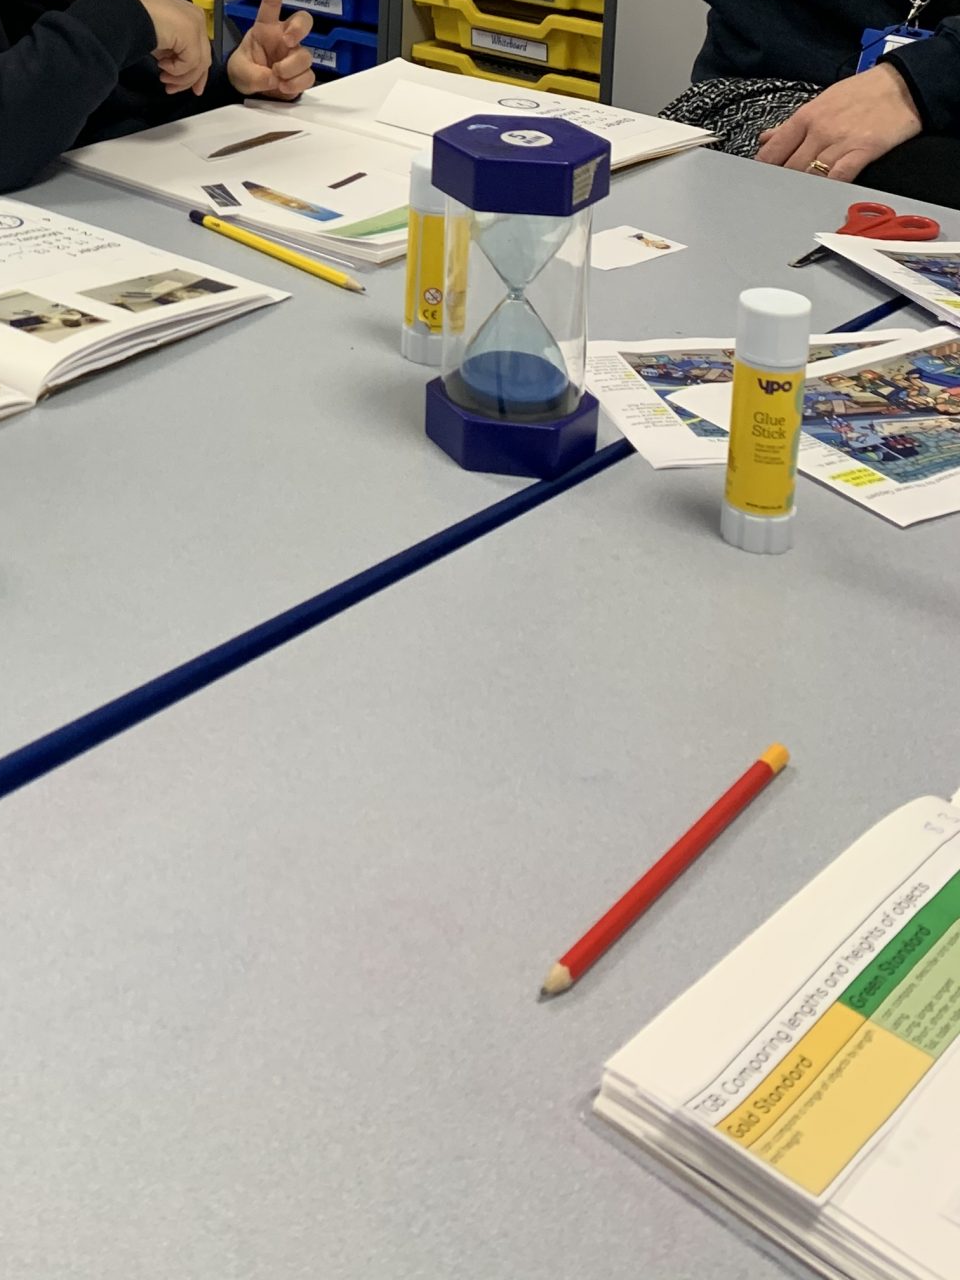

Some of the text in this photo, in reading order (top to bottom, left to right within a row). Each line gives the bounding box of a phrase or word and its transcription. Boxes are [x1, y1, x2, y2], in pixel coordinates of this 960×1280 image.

[491, 34, 527, 51] Whiteboard
[757, 377, 793, 395] ypo
[753, 411, 786, 426] Glue
[751, 424, 786, 439] Stick
[848, 923, 932, 1010] Green Standard
[721, 1029, 793, 1096] Comparing
[781, 987, 829, 1031] lengths
[824, 961, 850, 990] and
[843, 926, 887, 966] heights
[881, 911, 896, 929] of
[892, 881, 931, 918] objects
[726, 1054, 813, 1139] Gold Standard
